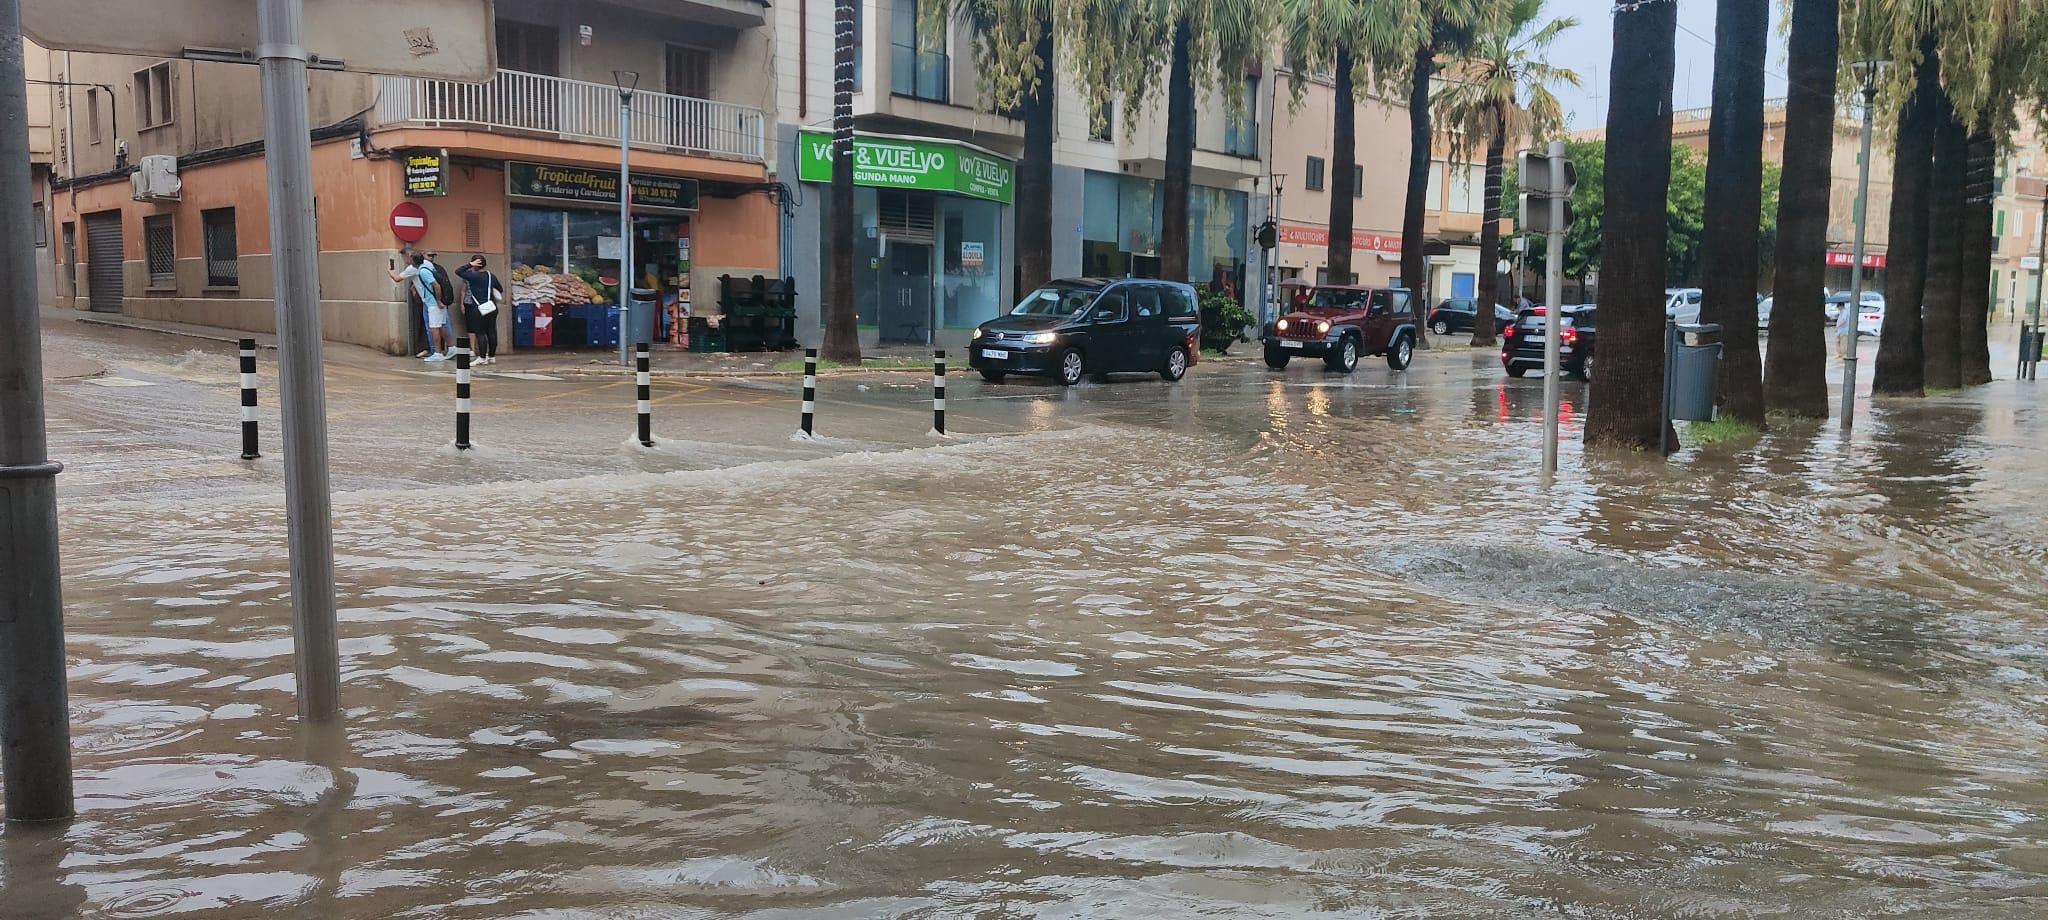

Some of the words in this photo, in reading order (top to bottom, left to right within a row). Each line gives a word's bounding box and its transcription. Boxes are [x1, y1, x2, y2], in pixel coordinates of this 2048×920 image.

[812, 143, 833, 162] VO
[857, 147, 871, 165] &
[960, 156, 976, 175] VOY
[976, 161, 981, 177] &
[854, 171, 887, 182] GUNDA
[889, 173, 916, 184] MANO
